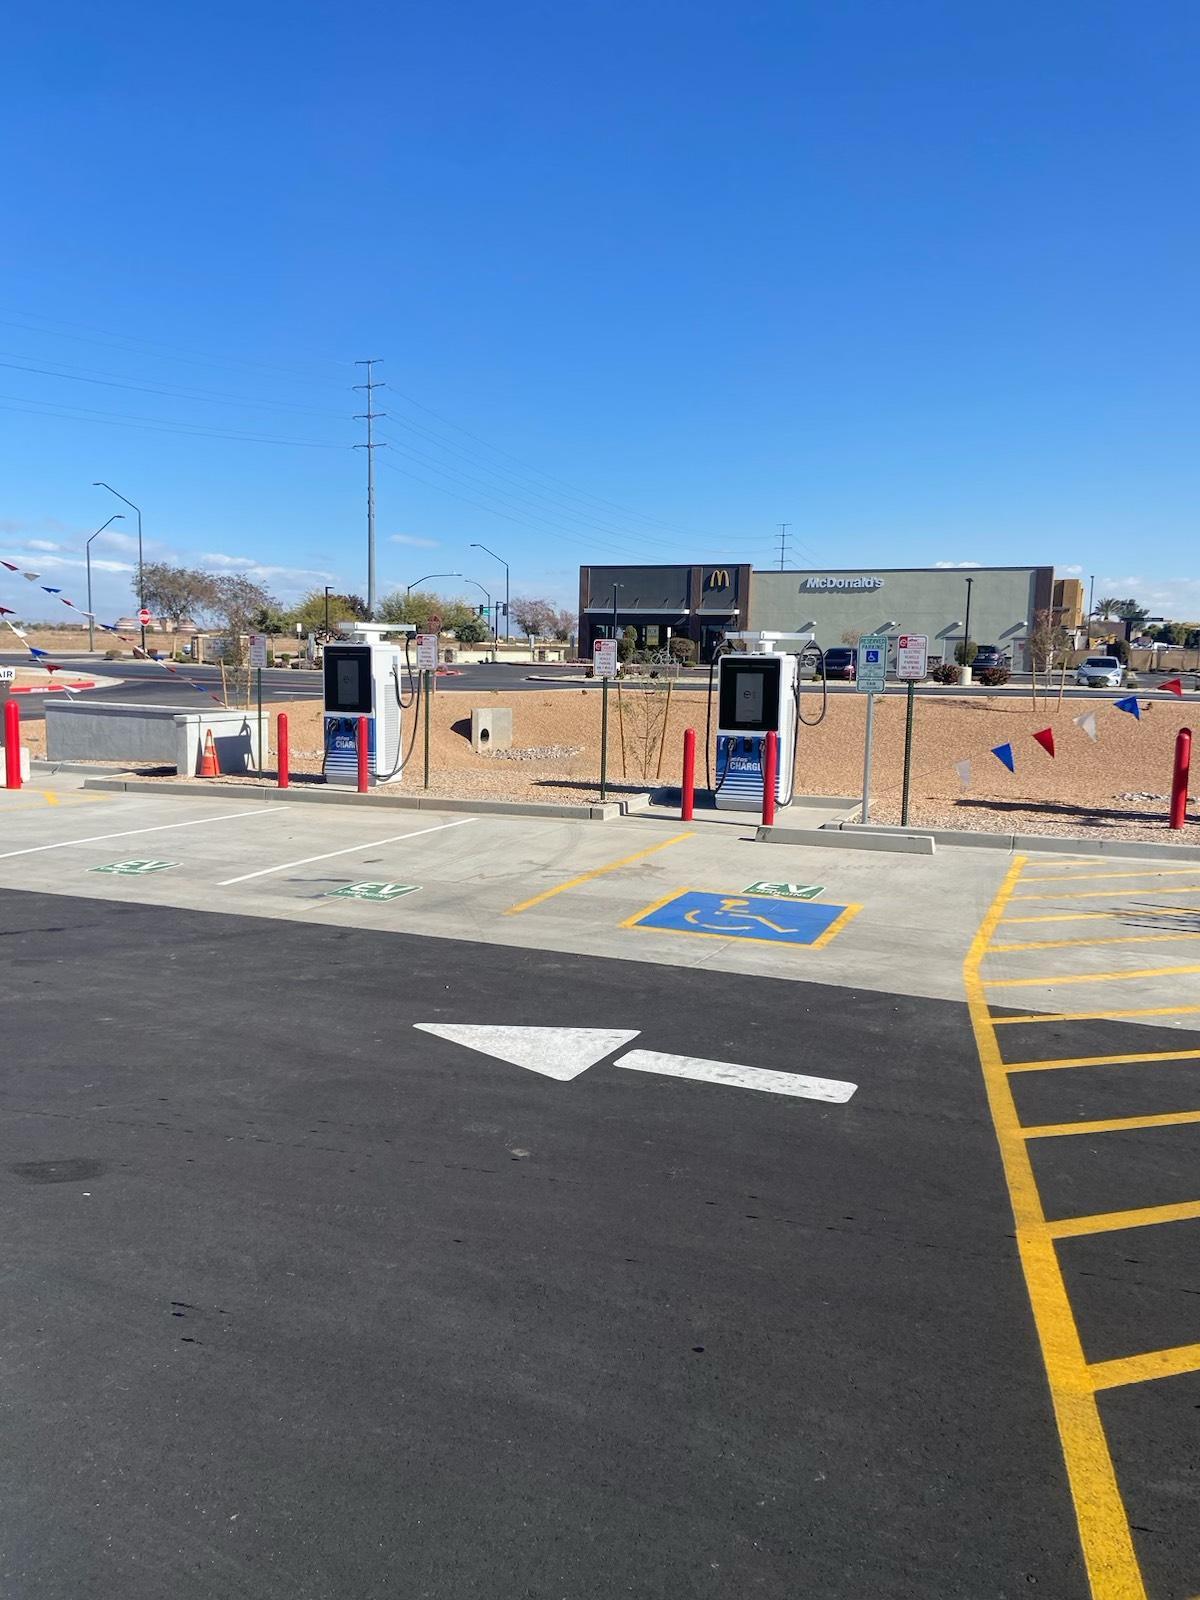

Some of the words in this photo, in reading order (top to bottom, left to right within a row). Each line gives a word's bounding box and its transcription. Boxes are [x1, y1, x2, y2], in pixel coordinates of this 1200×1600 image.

[806, 576, 884, 589] McDonald's
[350, 882, 415, 894] EV
[756, 882, 822, 893] EV
